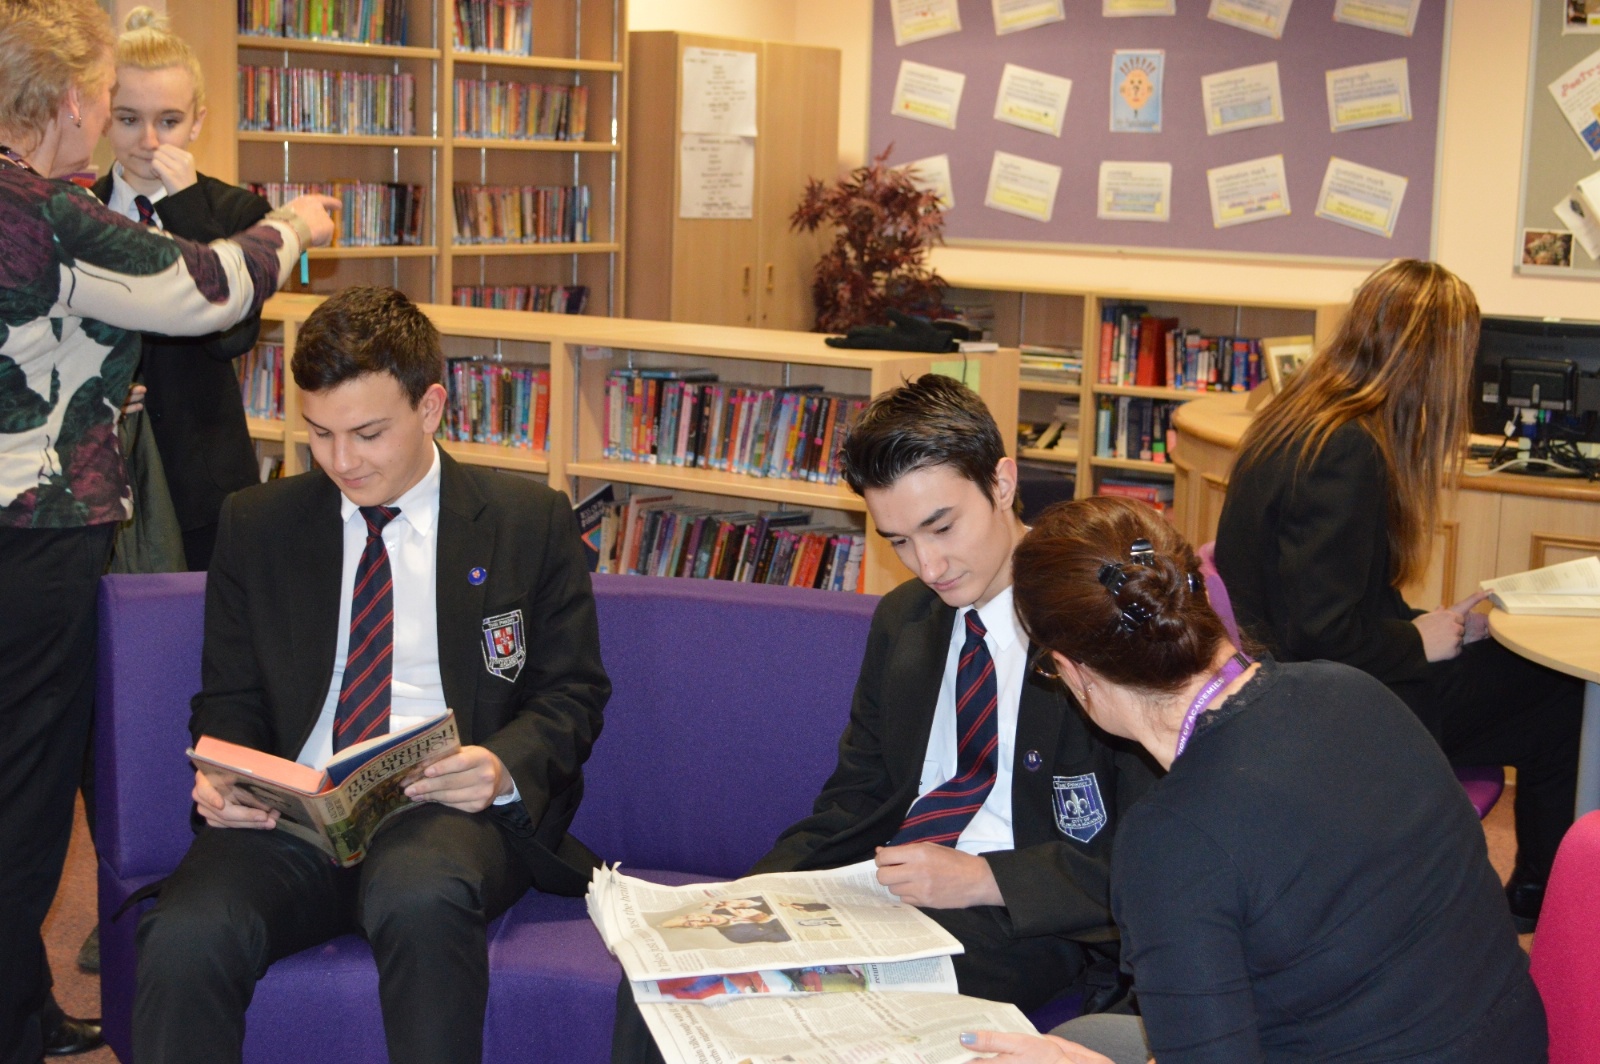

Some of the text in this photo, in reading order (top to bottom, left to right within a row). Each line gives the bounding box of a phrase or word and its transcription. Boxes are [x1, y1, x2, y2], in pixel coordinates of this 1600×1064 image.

[345, 724, 455, 793] THE BRITISH
[347, 734, 456, 802] REVOLUTION
[619, 881, 631, 903] brain
